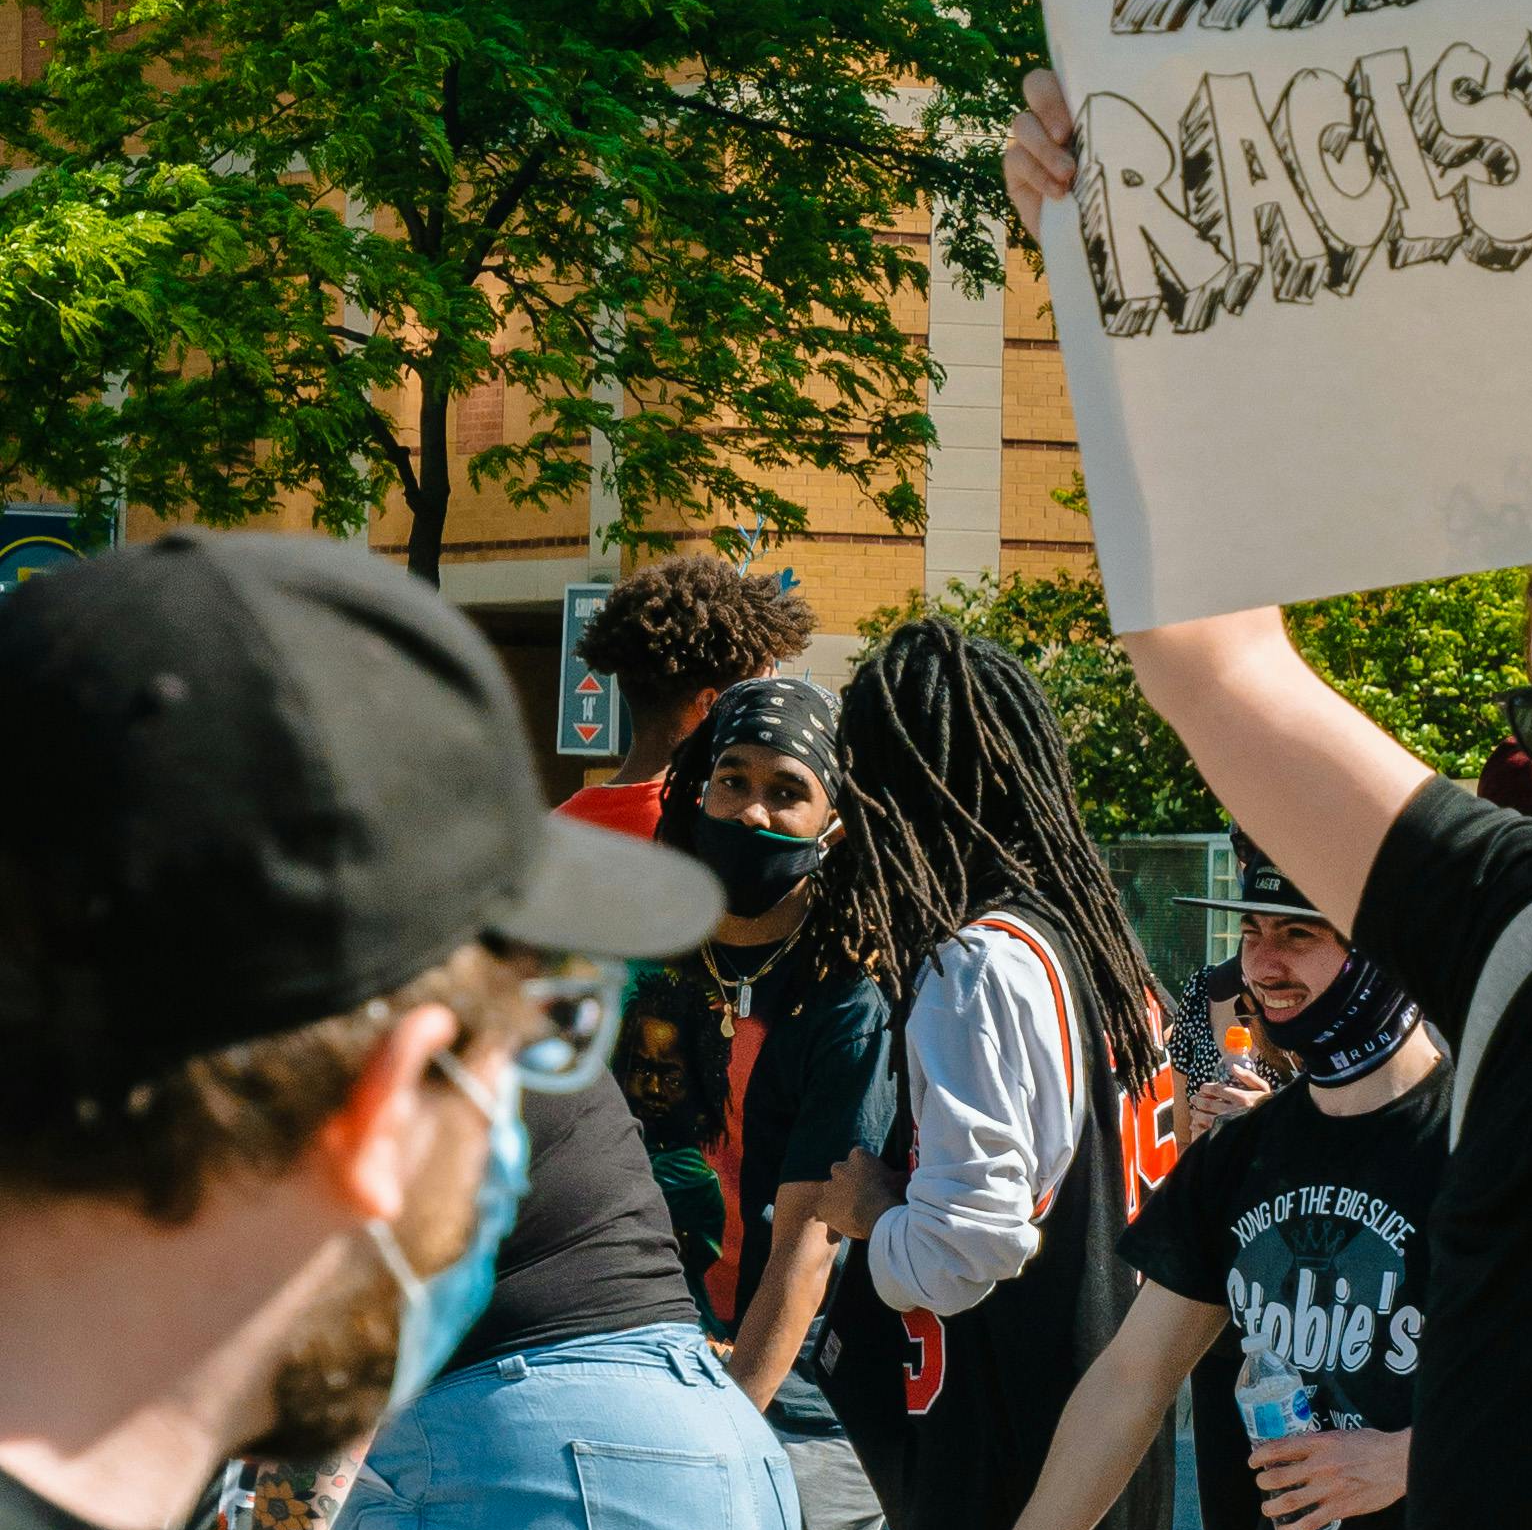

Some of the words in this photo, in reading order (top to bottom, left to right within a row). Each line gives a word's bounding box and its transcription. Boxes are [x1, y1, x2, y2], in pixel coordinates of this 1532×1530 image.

[1255, 877, 1281, 892] LAGER
[1231, 1202, 1272, 1249] KING
[1274, 1191, 1296, 1223] OF
[1299, 1185, 1335, 1216] THE
[1334, 1187, 1369, 1221] BIG
